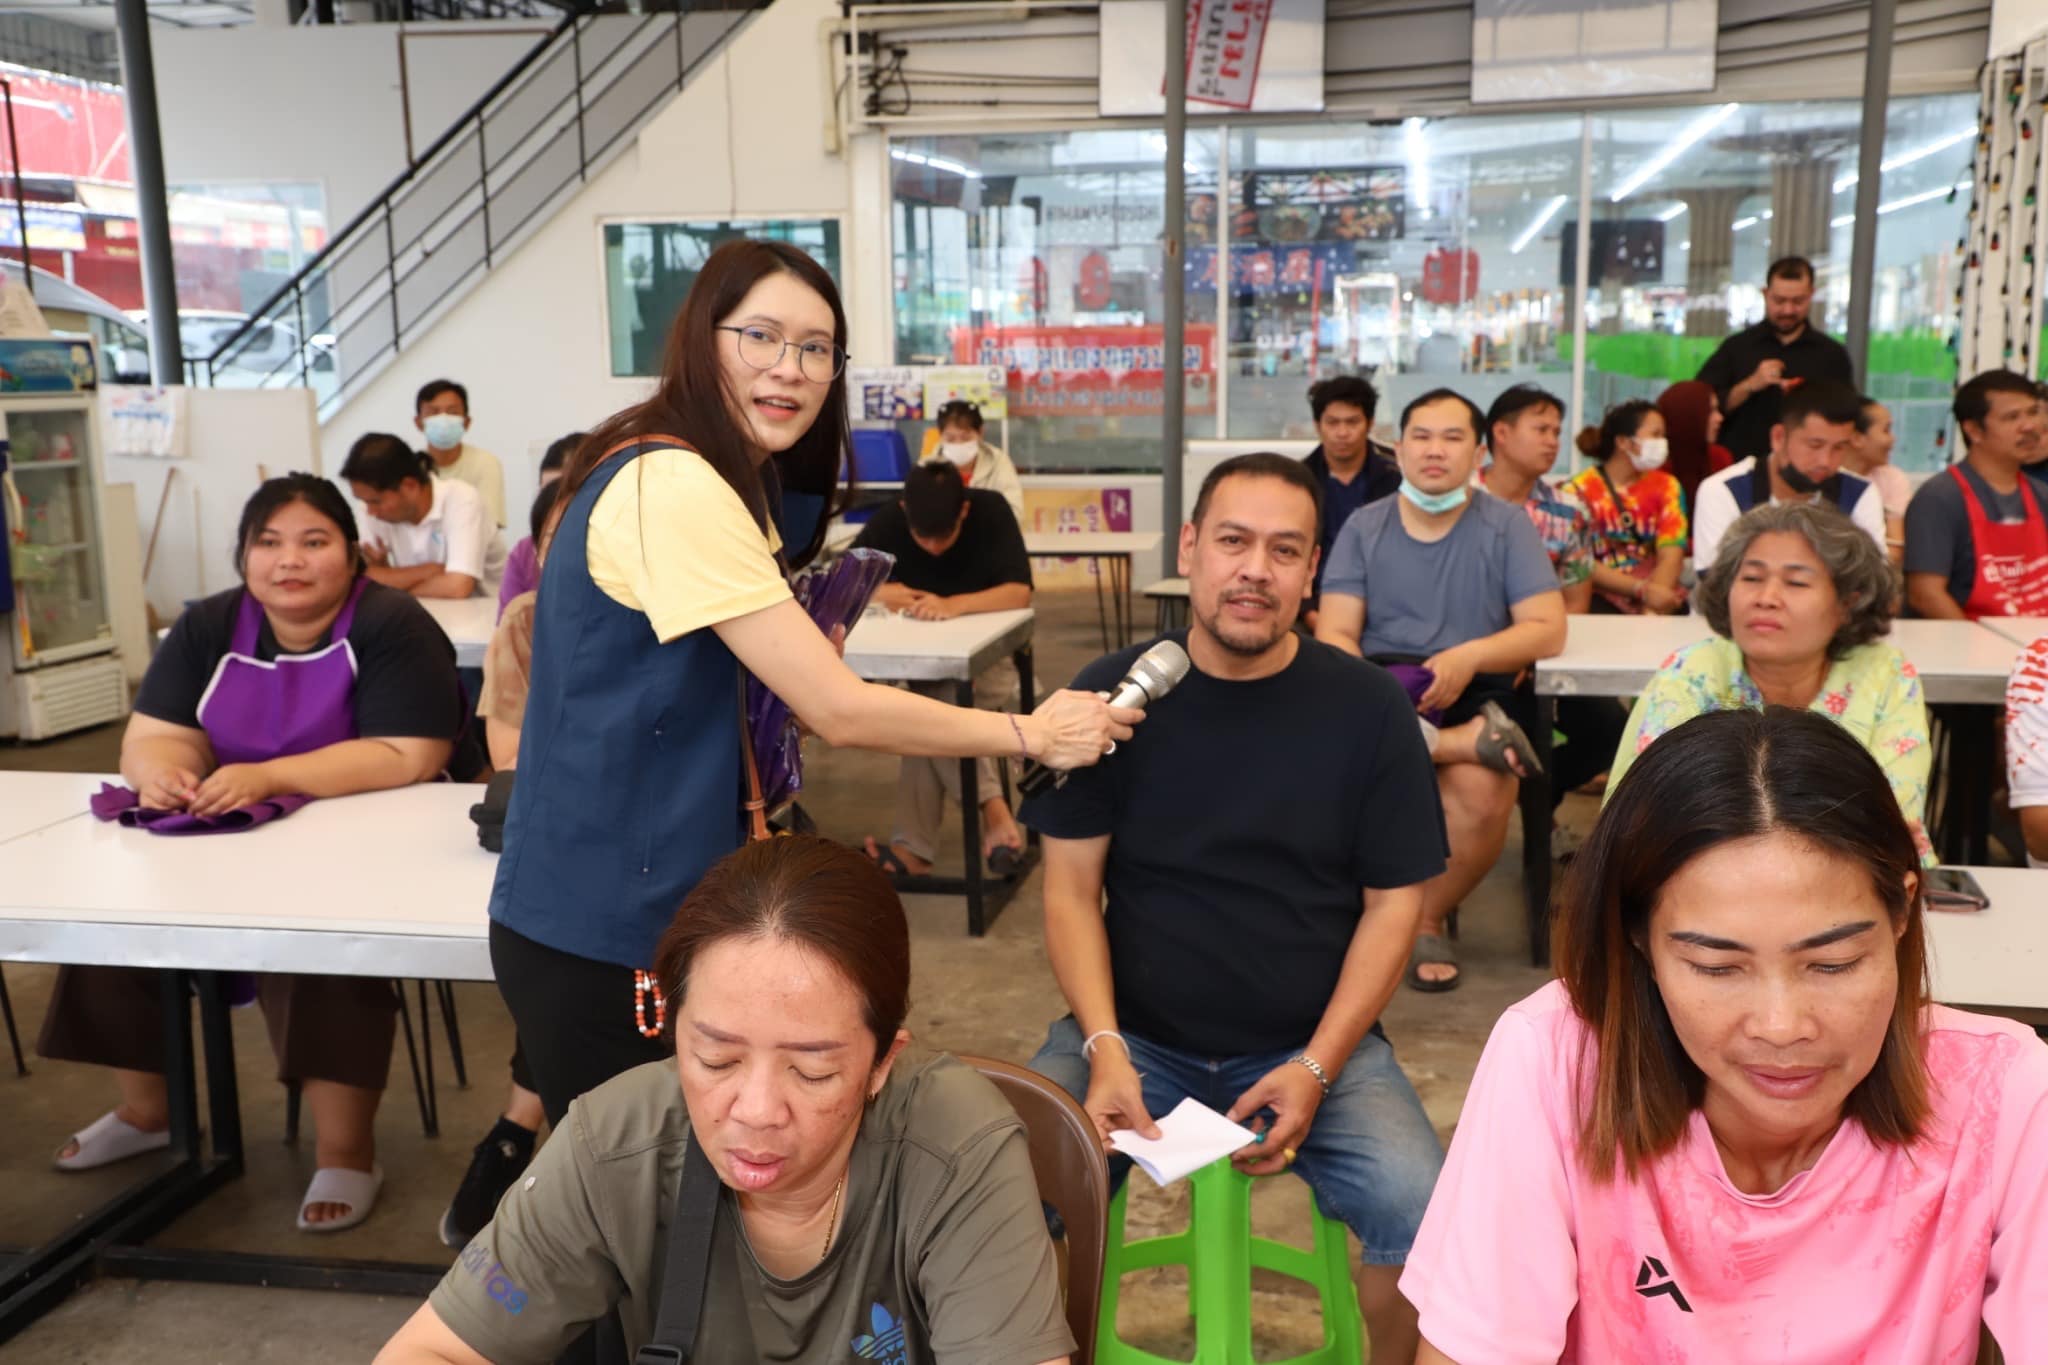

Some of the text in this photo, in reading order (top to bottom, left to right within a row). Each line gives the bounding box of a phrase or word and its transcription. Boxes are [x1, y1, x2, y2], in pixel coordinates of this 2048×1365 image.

[978, 338, 1202, 385] ข้าวหมูแดงนครปม
[460, 1243, 530, 1317] dias
